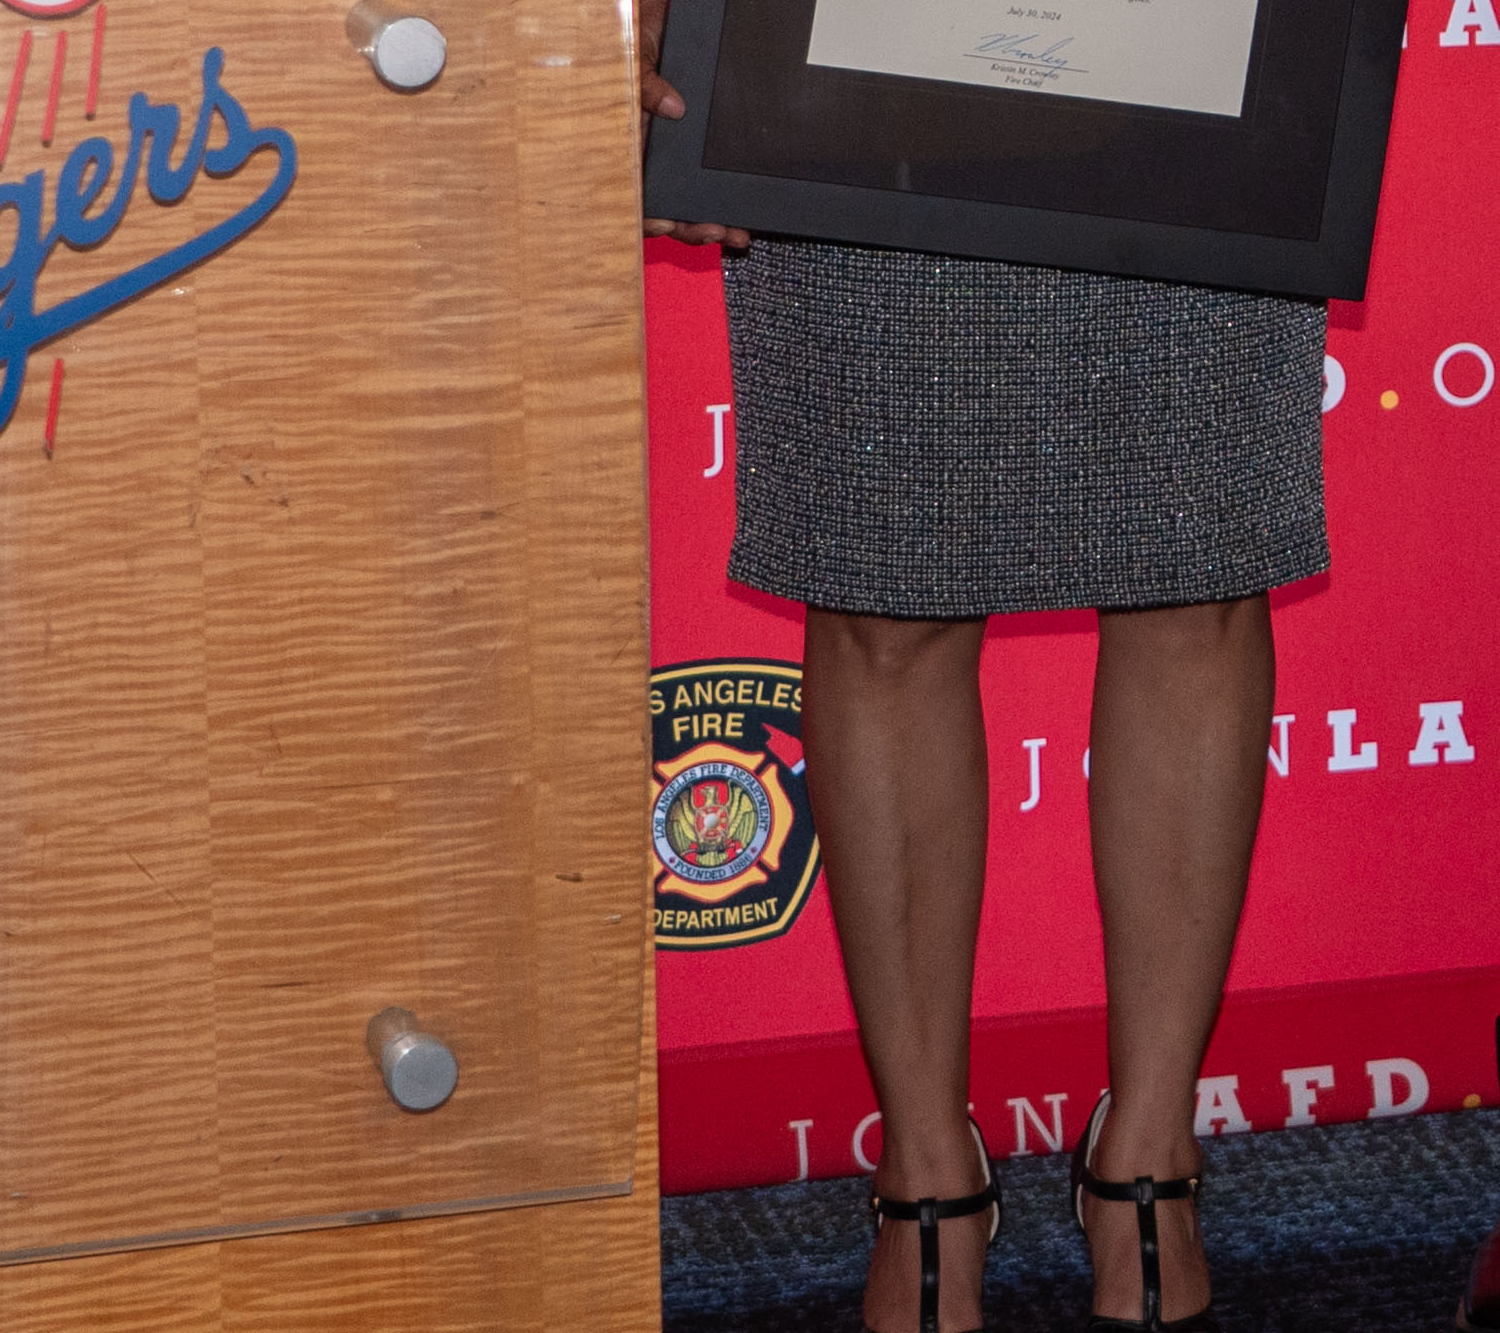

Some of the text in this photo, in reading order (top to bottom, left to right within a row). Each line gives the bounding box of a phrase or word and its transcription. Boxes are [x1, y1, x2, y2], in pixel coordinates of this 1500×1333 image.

[673, 679, 802, 712] ANGELES
[673, 713, 745, 742] FIRE
[700, 764, 727, 776] FIRE
[731, 768, 769, 833] DEPARTMENT
[673, 859, 726, 881] FOUNDED
[654, 897, 778, 929] DEPARTMENT
